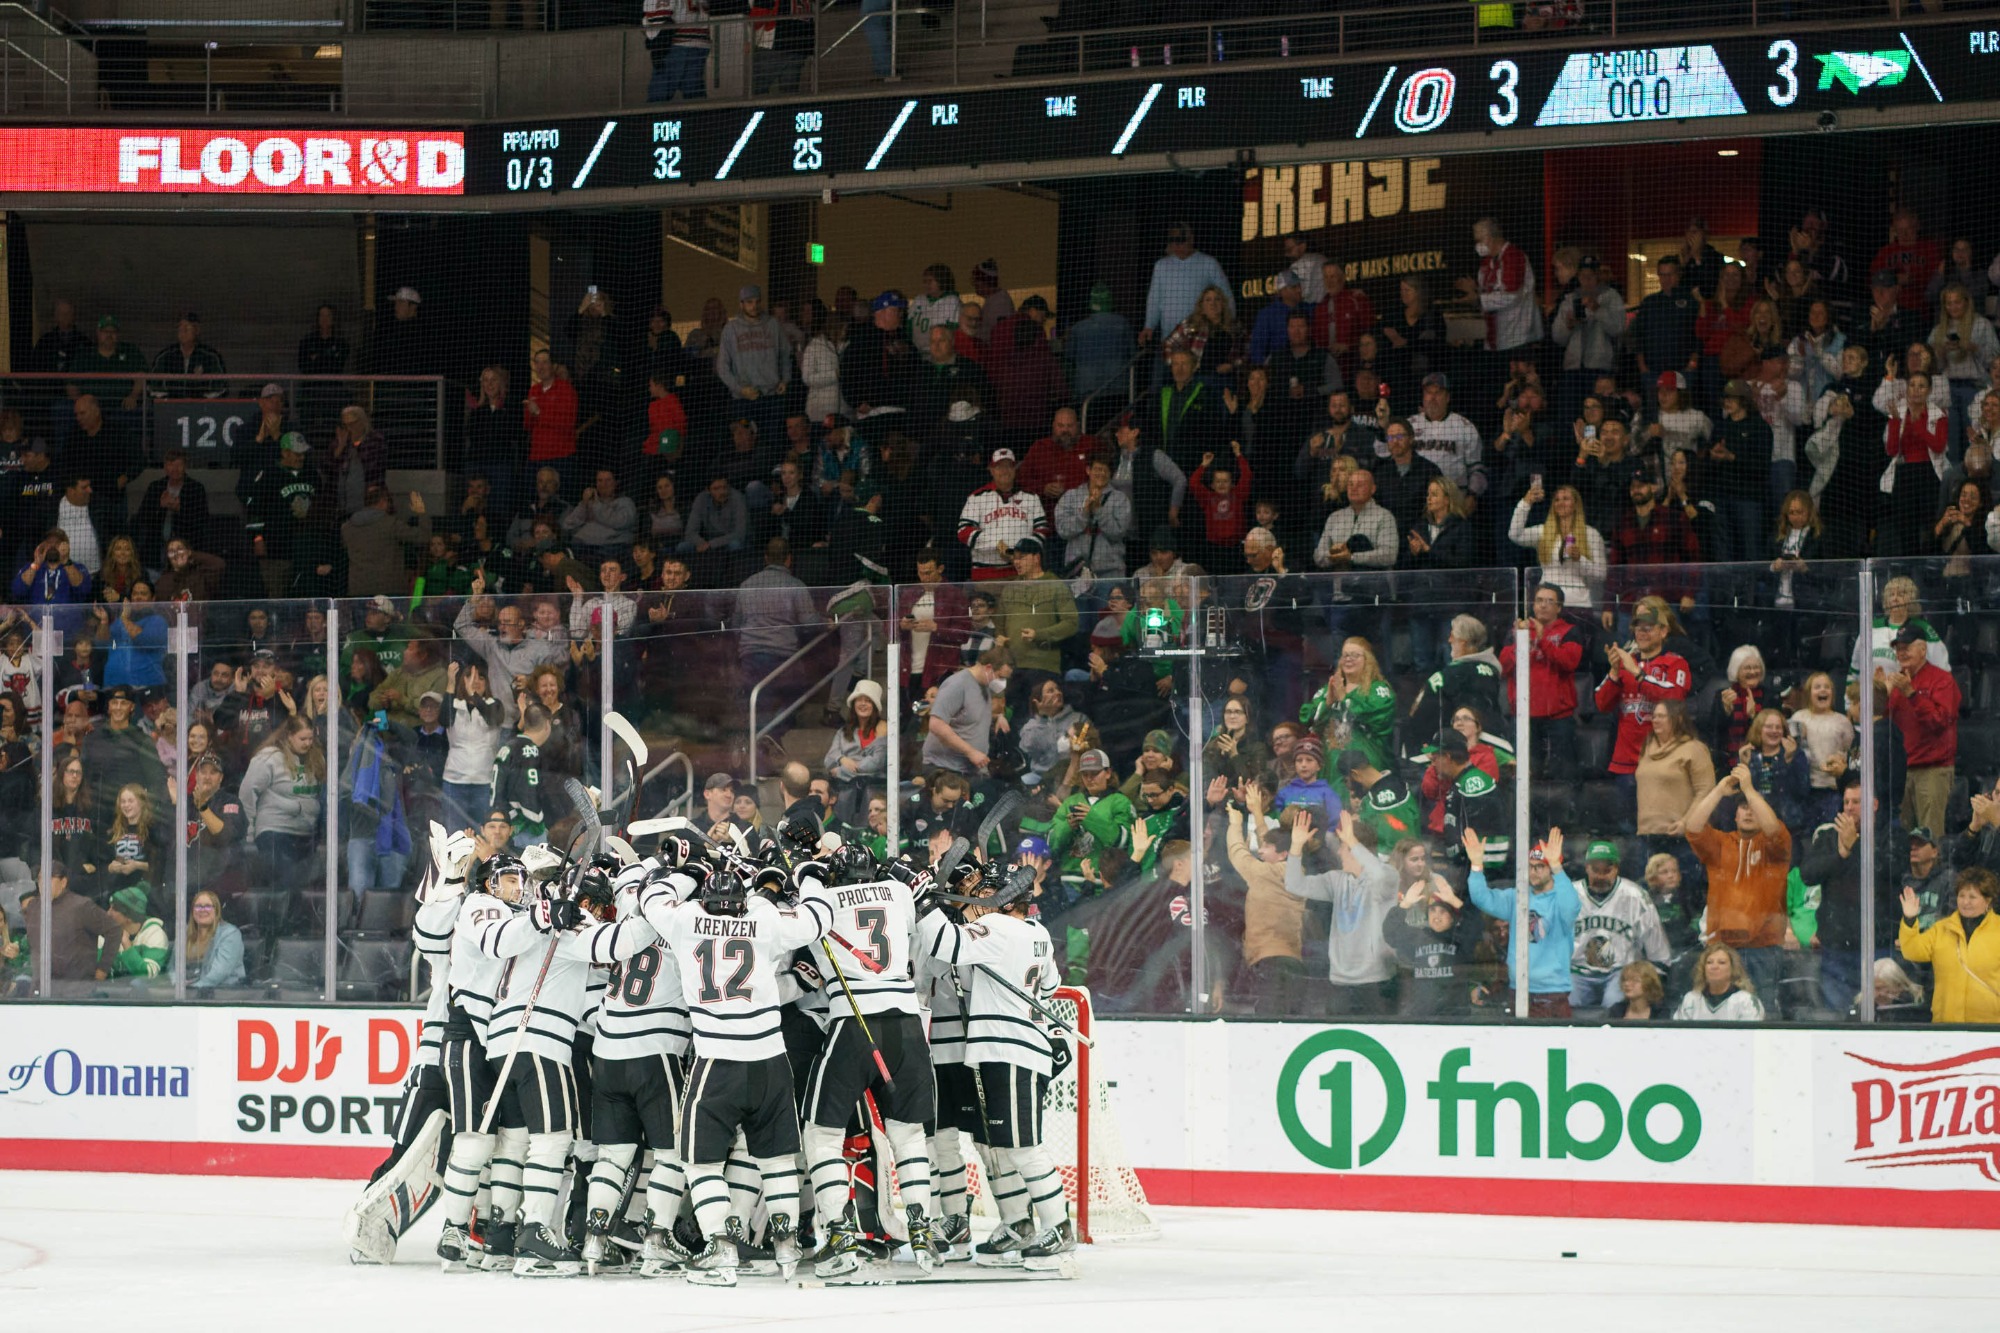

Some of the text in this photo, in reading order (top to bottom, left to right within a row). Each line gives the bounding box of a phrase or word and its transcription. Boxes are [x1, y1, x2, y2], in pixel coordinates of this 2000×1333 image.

[1590, 46, 1691, 79] PERIOD 4
[1767, 39, 1798, 106] 3
[1178, 87, 1206, 108] PLR
[1300, 77, 1334, 99] TIME
[1489, 60, 1519, 126] 3
[931, 104, 959, 125] PLR
[1045, 95, 1077, 116] TIME
[653, 121, 682, 142] FOW
[795, 111, 823, 132] SOG
[118, 136, 351, 187] FLOOR
[653, 147, 682, 179] 32
[793, 138, 823, 170] 25
[506, 157, 553, 191] 0/3
[1676, 669, 1686, 687] 8
[528, 769, 539, 785] 9
[116, 840, 139, 857] 25
[837, 886, 894, 908] PROCTOR
[471, 907, 500, 926] 20
[694, 916, 757, 938] KRENZEN
[1575, 915, 1632, 940] SIOUX
[854, 907, 891, 972] 3
[693, 938, 757, 1004] 12
[368, 1018, 424, 1085] D
[8, 1055, 42, 1091] of
[1427, 1047, 1702, 1163] fnbo
[1851, 1078, 2000, 1151] Pizza
